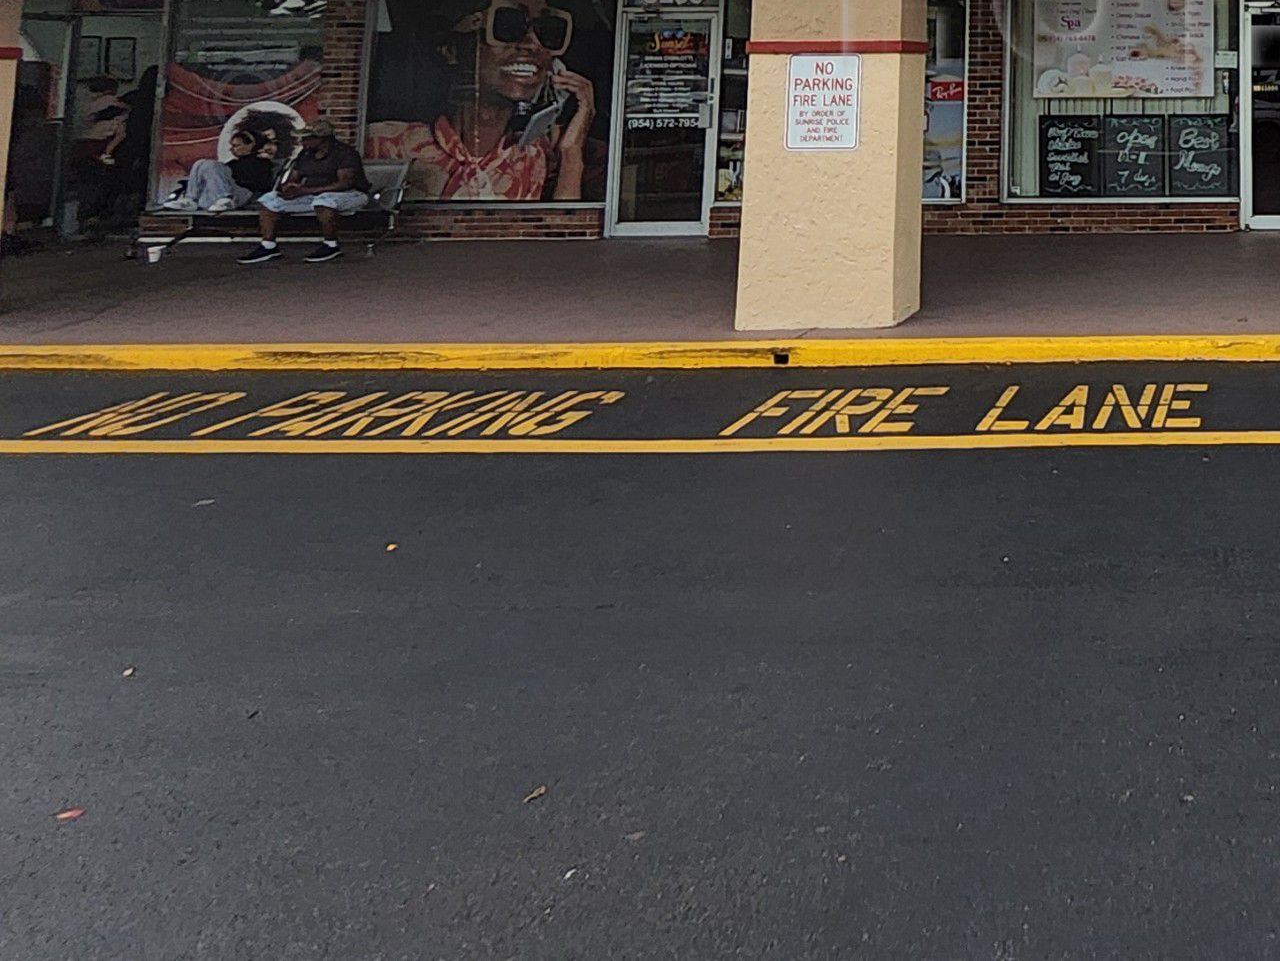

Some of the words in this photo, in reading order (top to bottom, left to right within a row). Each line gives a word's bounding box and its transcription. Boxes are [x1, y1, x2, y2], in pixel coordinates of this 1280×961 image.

[1060, 15, 1081, 30] Spa
[815, 61, 834, 76] NO
[794, 77, 853, 92] PARKING
[793, 94, 817, 107] FIRE
[823, 94, 853, 107] LANE
[799, 110, 808, 118] BY
[811, 110, 834, 118] ORDER
[836, 110, 846, 118] OF
[627, 119, 654, 130] (954)
[795, 118, 823, 126] SUNRISE
[826, 118, 849, 126] POLICE
[806, 126, 821, 134] AND
[823, 126, 838, 134] FIRE
[799, 134, 843, 143] DEPARTMENT
[1117, 170, 1130, 184] 7
[22, 390, 248, 437] NO
[190, 390, 626, 437] PARKING
[718, 385, 951, 437] FIRE
[974, 383, 1209, 432] LANE
